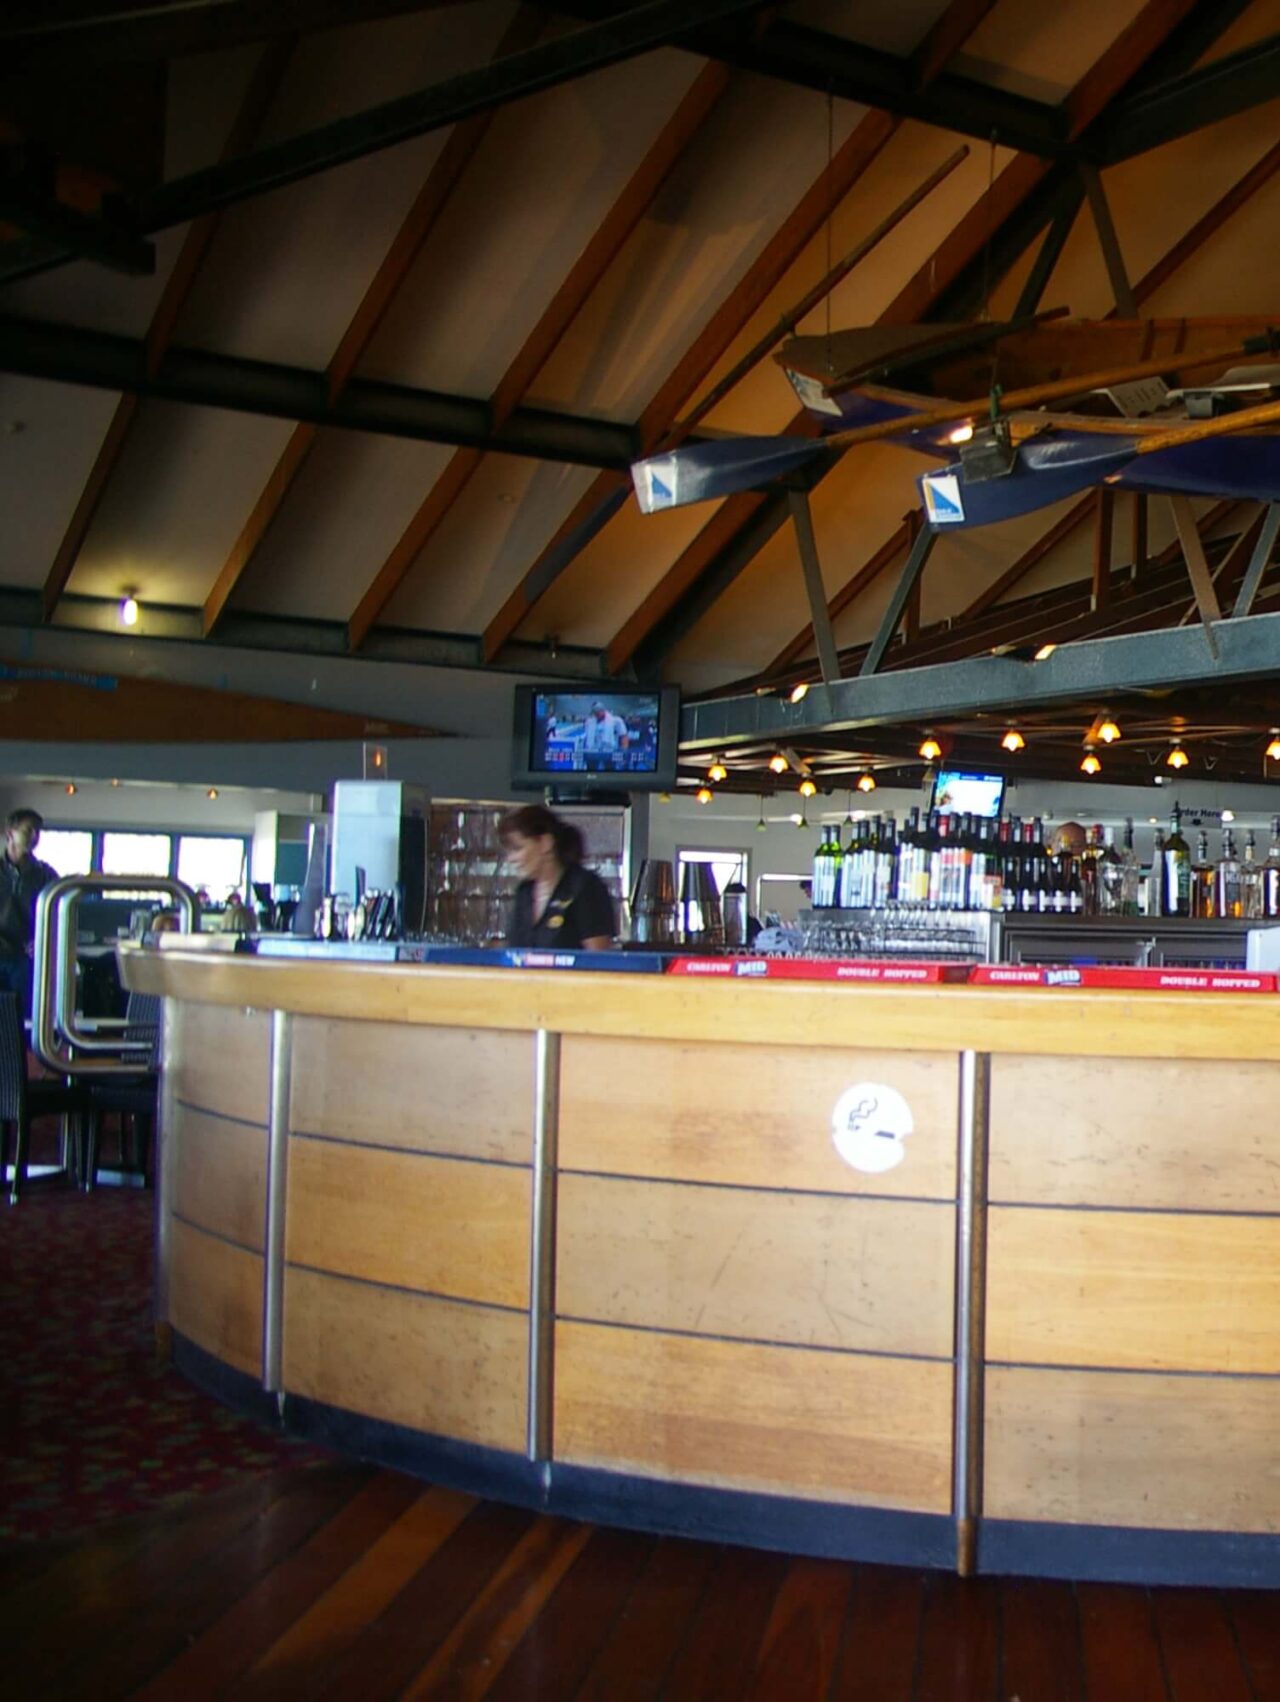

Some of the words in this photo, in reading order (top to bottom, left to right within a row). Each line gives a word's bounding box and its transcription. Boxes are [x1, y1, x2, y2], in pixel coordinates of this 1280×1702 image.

[686, 961, 731, 973] CARLTON
[736, 961, 768, 976] MID
[836, 967, 879, 978] DOUBLE
[883, 968, 928, 979] HOPPED
[989, 970, 1040, 982] CARLTON
[1046, 969, 1081, 985] MID
[1160, 975, 1208, 987] DOUBLE
[1211, 977, 1261, 989] HOPPED
